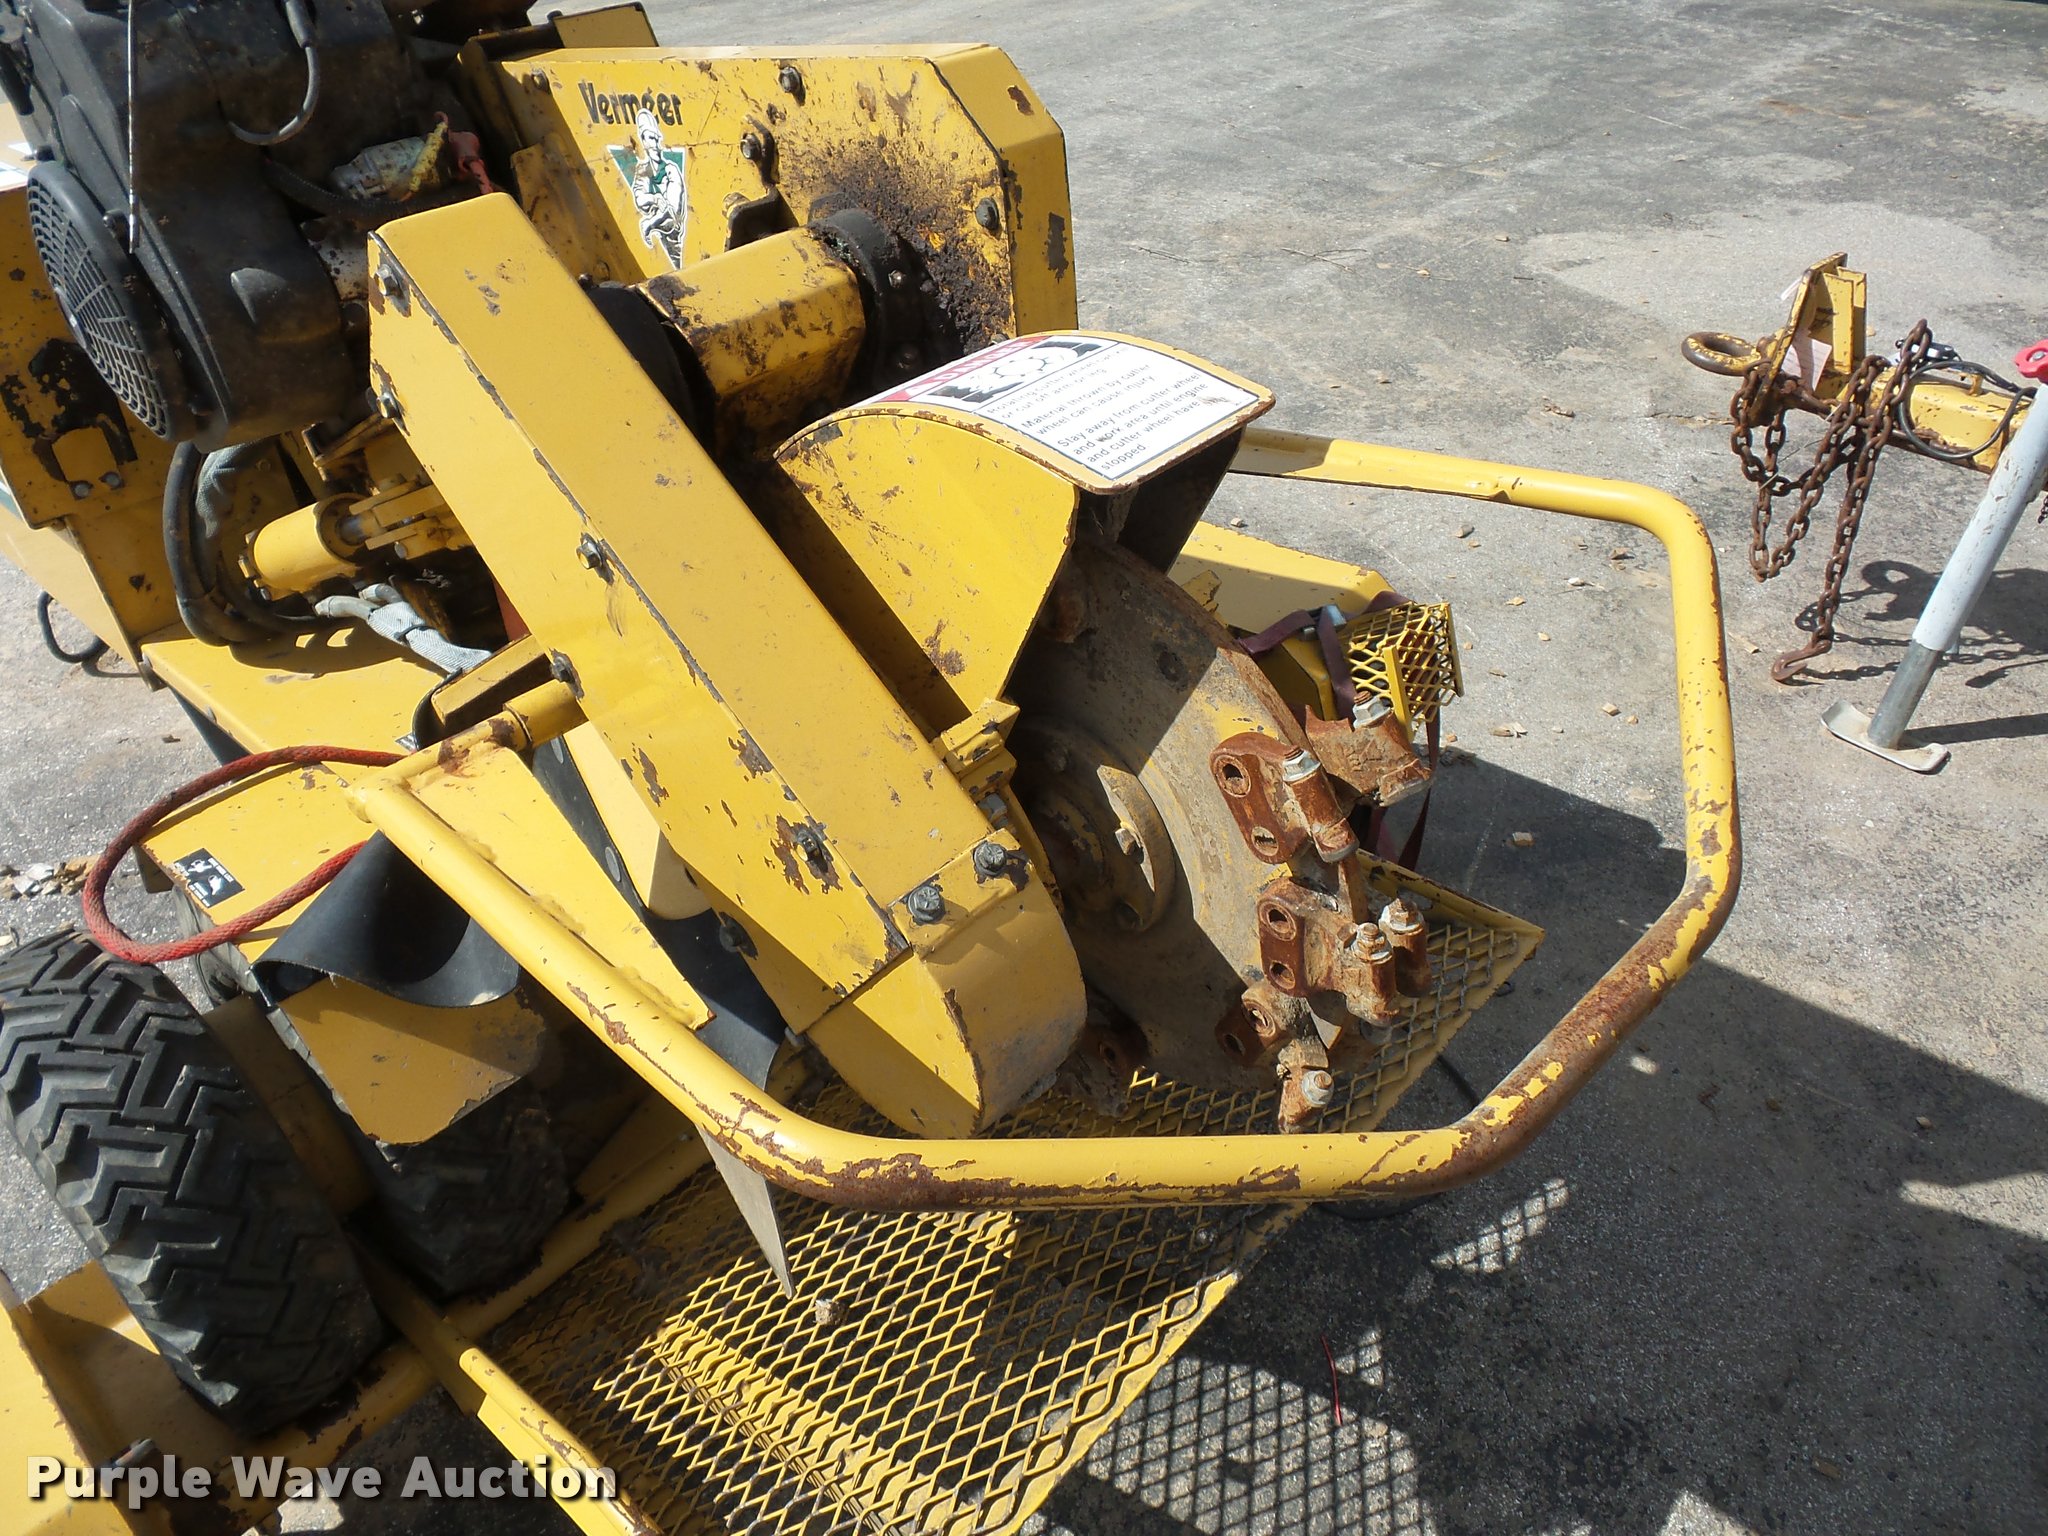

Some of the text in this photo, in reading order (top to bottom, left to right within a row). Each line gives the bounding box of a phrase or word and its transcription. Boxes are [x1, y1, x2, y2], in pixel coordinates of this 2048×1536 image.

[577, 82, 683, 126] Vermeer
[1021, 404, 1068, 429] Material
[1067, 386, 1105, 406] thrown
[1104, 379, 1122, 389] by
[1036, 416, 1070, 435] wheel
[1070, 406, 1091, 418] can
[1057, 372, 1201, 447] Stay away from cutter wheel
[1073, 440, 1096, 455] and
[1125, 414, 1149, 428] area
[1149, 400, 1174, 415] until
[1173, 383, 1208, 402] engine
[1087, 400, 1201, 463] and cutter wheel have
